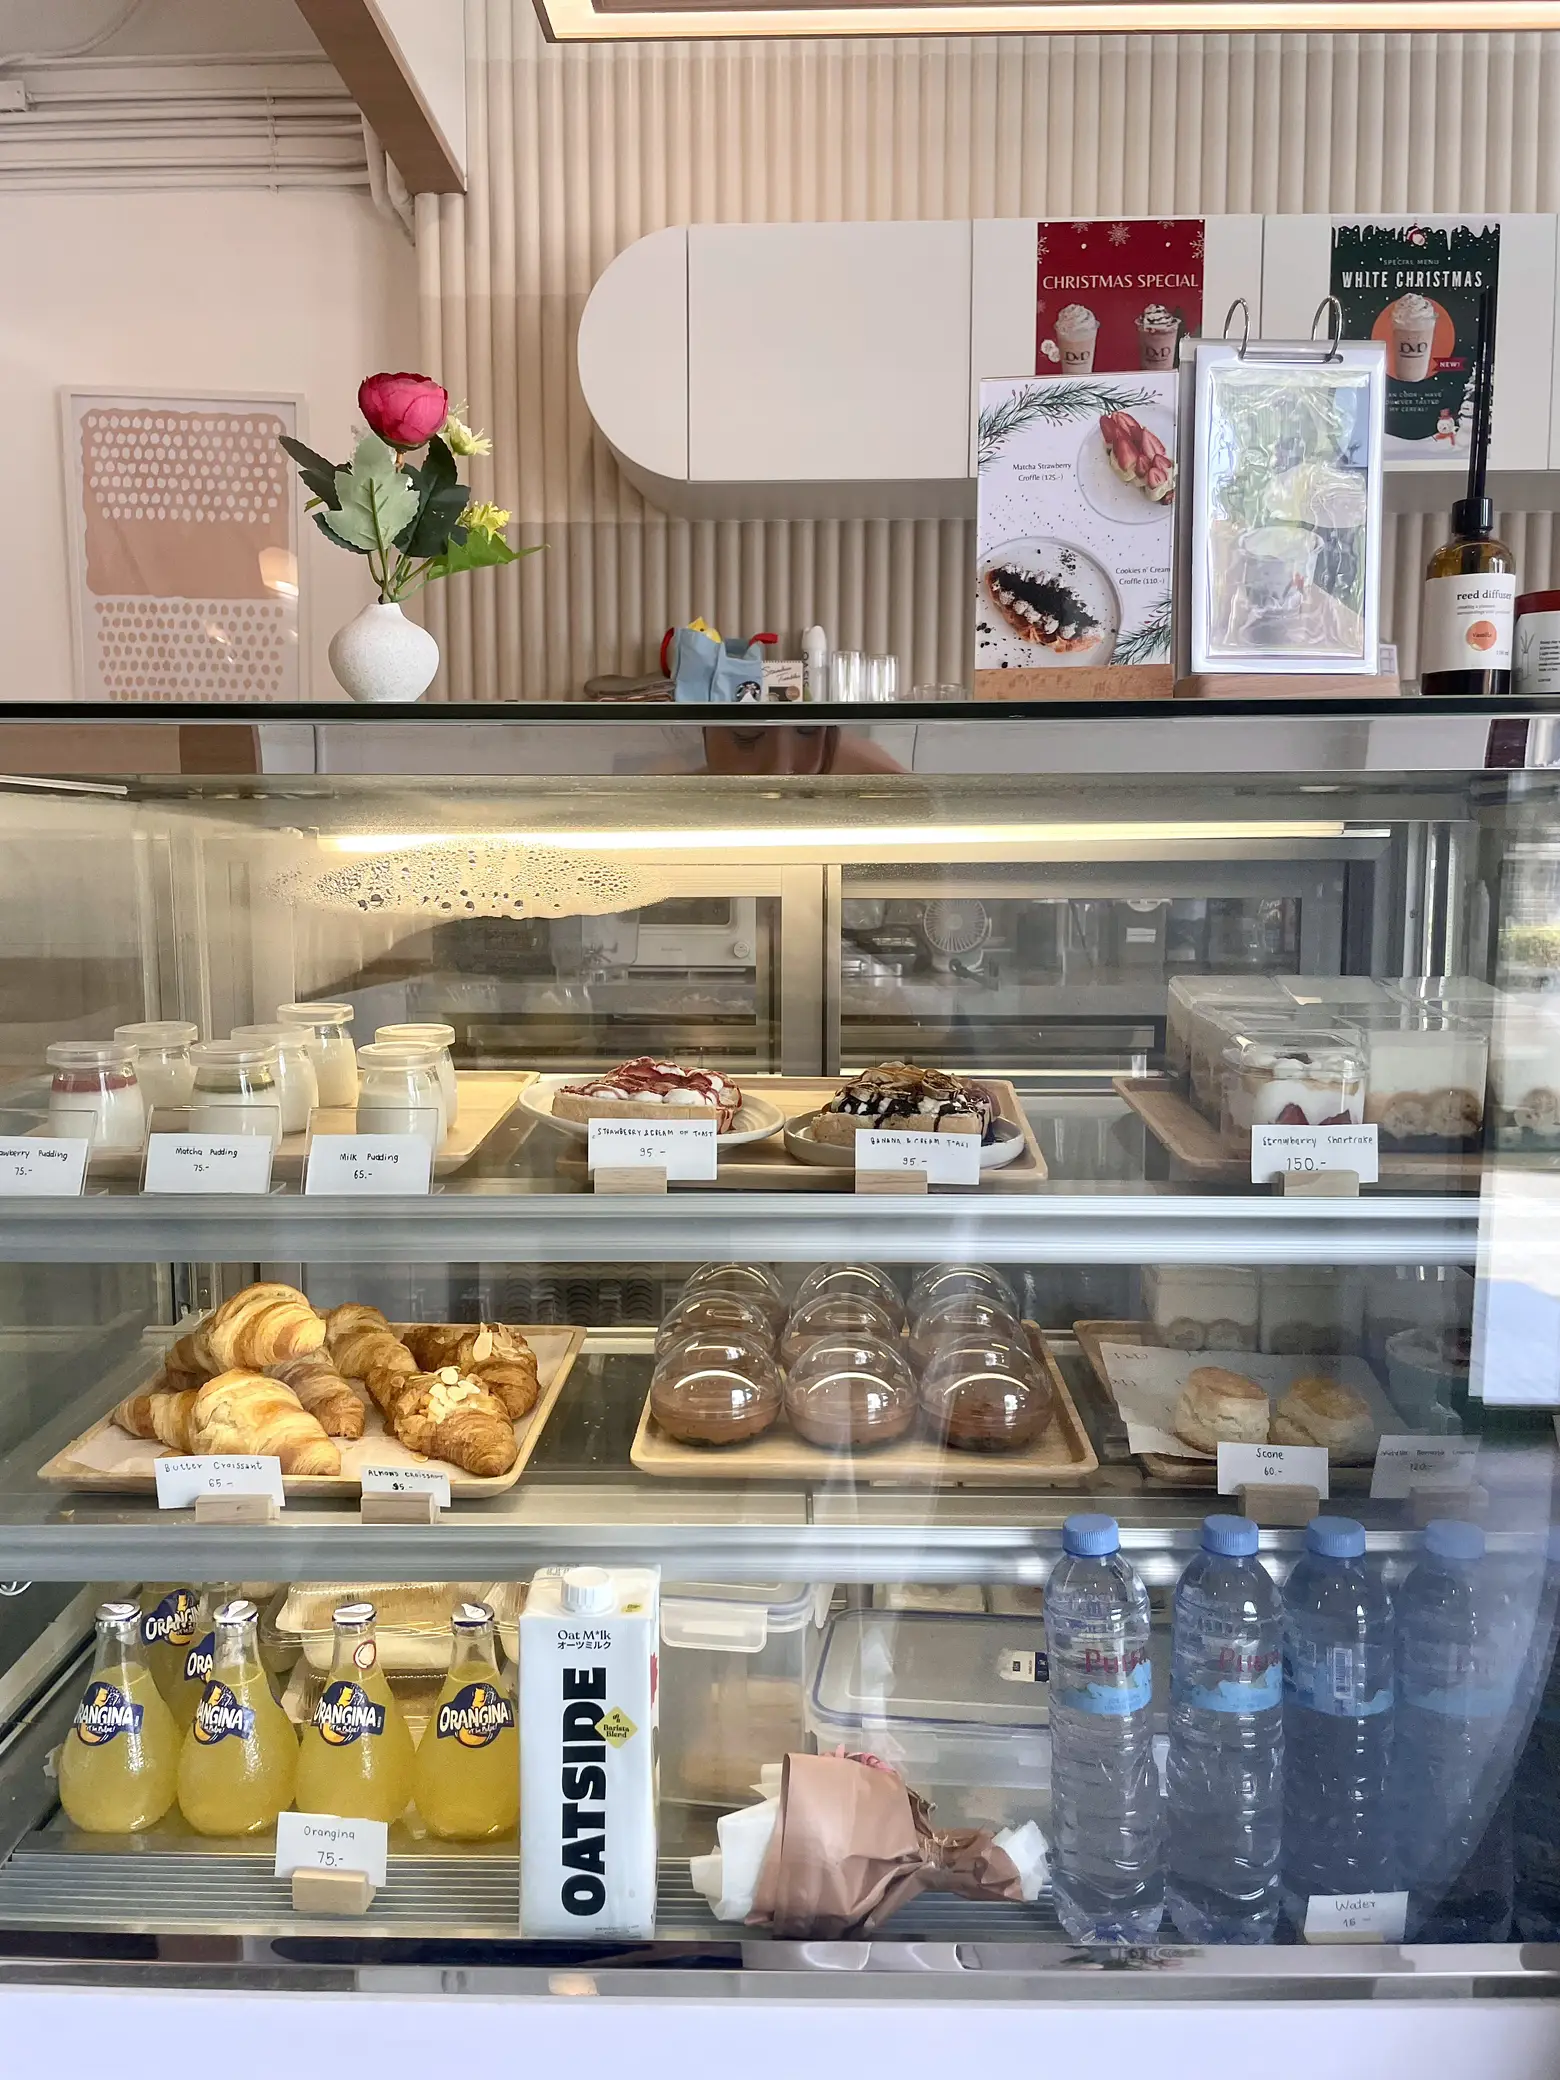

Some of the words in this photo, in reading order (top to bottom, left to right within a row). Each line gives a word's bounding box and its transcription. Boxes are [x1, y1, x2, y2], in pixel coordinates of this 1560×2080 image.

[1042, 275, 1133, 290] CHRISTMAS
[1137, 273, 1199, 288] SPECIAL
[1342, 271, 1388, 288] WHITE
[1396, 270, 1483, 288] CHRISTMAS
[1038, 462, 1071, 471] Strawberry
[1457, 590, 1480, 600] reed
[1482, 589, 1512, 600] diffuser
[597, 1127, 641, 1137] STRAWBERRY
[870, 1136, 901, 1145] BANANA
[1262, 1136, 1317, 1148] Strawberry
[38, 1149, 68, 1161] Pudding
[175, 1147, 202, 1156] Matcha
[209, 1148, 238, 1158] Pudding
[339, 1153, 358, 1161] Milk
[366, 1153, 400, 1163] Pudding
[193, 1164, 210, 1172] 75.-
[1286, 1157, 1326, 1171] 150.-
[14, 1166, 32, 1176] 75.-
[353, 1170, 373, 1179] 65.-
[1256, 1447, 1284, 1460] Scone
[164, 1463, 203, 1473] Butter
[213, 1460, 264, 1470] Croissant
[1264, 1466, 1282, 1476] 60.-
[557, 1629, 581, 1640] Oat
[557, 1641, 611, 1650] オーツミルク
[187, 1652, 213, 1676] ORA
[313, 1697, 376, 1728] ORANGINA
[440, 1701, 509, 1732] ORANGINA
[603, 1724, 630, 1732] Barista
[561, 1667, 607, 1916] OATSIDE
[303, 1825, 355, 1841] Orangina
[317, 1851, 344, 1867] 75.-
[1335, 1898, 1376, 1912] Water
